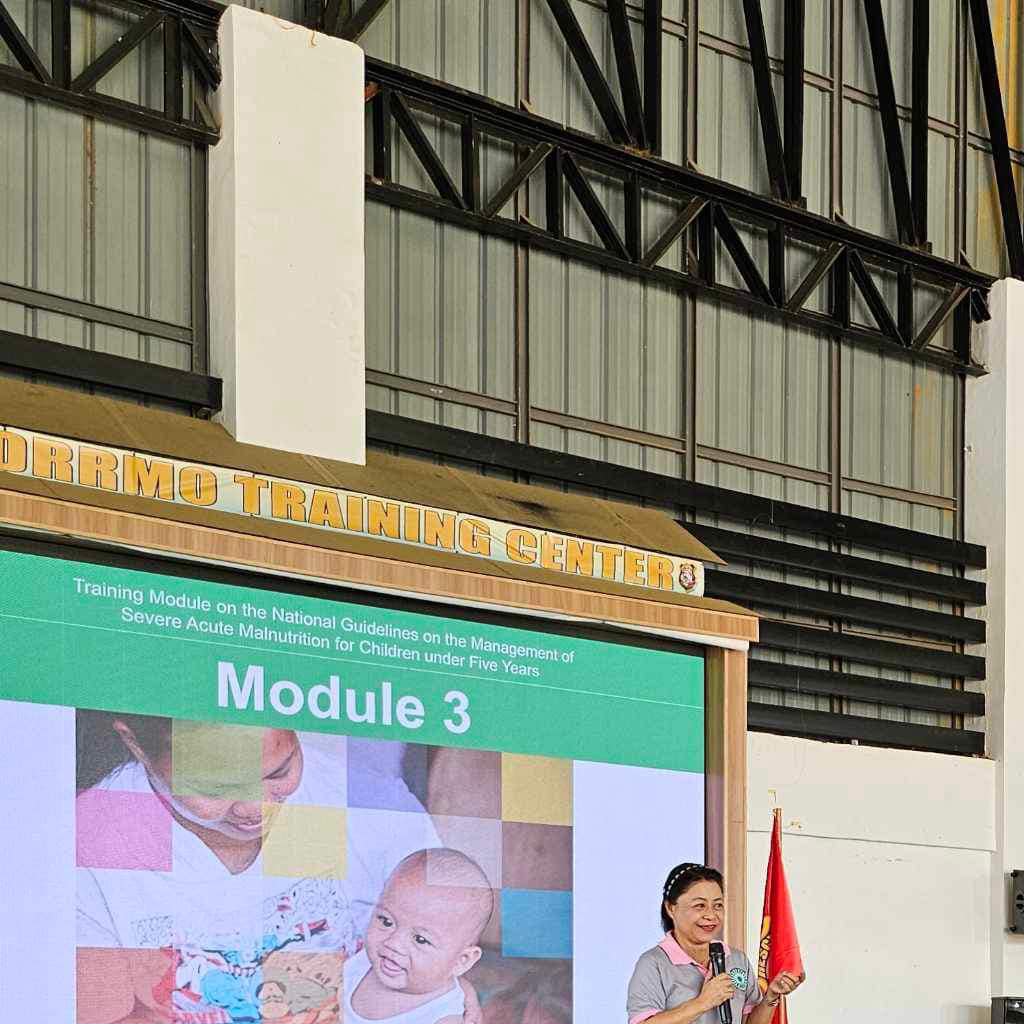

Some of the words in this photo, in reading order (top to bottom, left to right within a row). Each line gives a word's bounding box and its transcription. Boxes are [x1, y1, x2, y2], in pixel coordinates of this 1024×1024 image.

[233, 474, 491, 557] TRAINING
[506, 529, 674, 590] CENTER
[73, 577, 144, 605] Training
[150, 590, 211, 612] Module
[216, 601, 237, 616] on
[241, 602, 267, 620] the
[272, 606, 336, 630] National
[341, 617, 419, 641] Guidelines
[423, 631, 441, 645] on
[444, 633, 467, 649] the
[471, 636, 561, 664] Management
[562, 650, 575, 664] of
[121, 606, 183, 629] Severe
[186, 616, 234, 636] Acute
[239, 624, 330, 650] Malnutrition
[335, 637, 355, 652] for
[359, 640, 420, 662] Children
[424, 649, 466, 667] under
[469, 656, 498, 673] Five
[502, 661, 540, 677] Years
[217, 661, 425, 729] Module
[443, 690, 472, 735] 3
